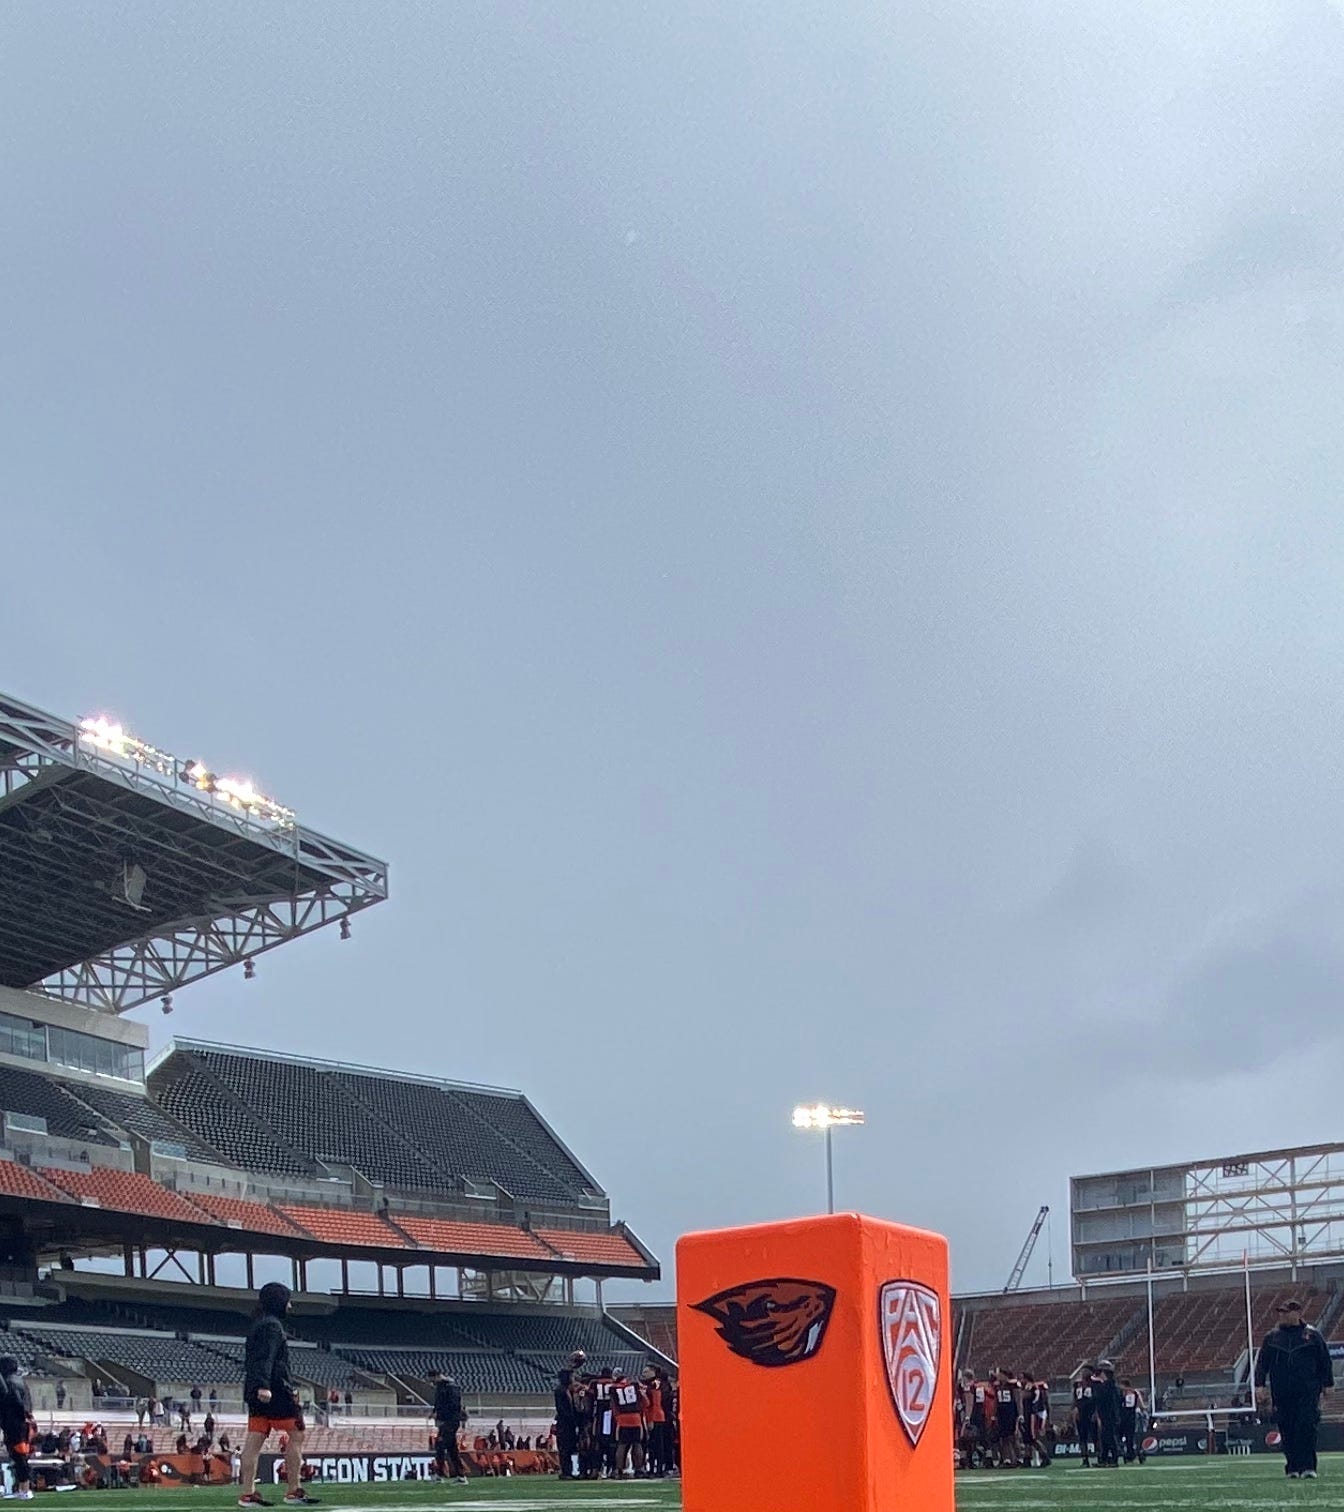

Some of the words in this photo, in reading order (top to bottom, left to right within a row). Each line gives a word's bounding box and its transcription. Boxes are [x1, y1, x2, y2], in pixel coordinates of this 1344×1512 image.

[902, 1369, 926, 1412] 12
[1159, 1436, 1187, 1447] pepsi
[273, 1458, 368, 1484] EGON
